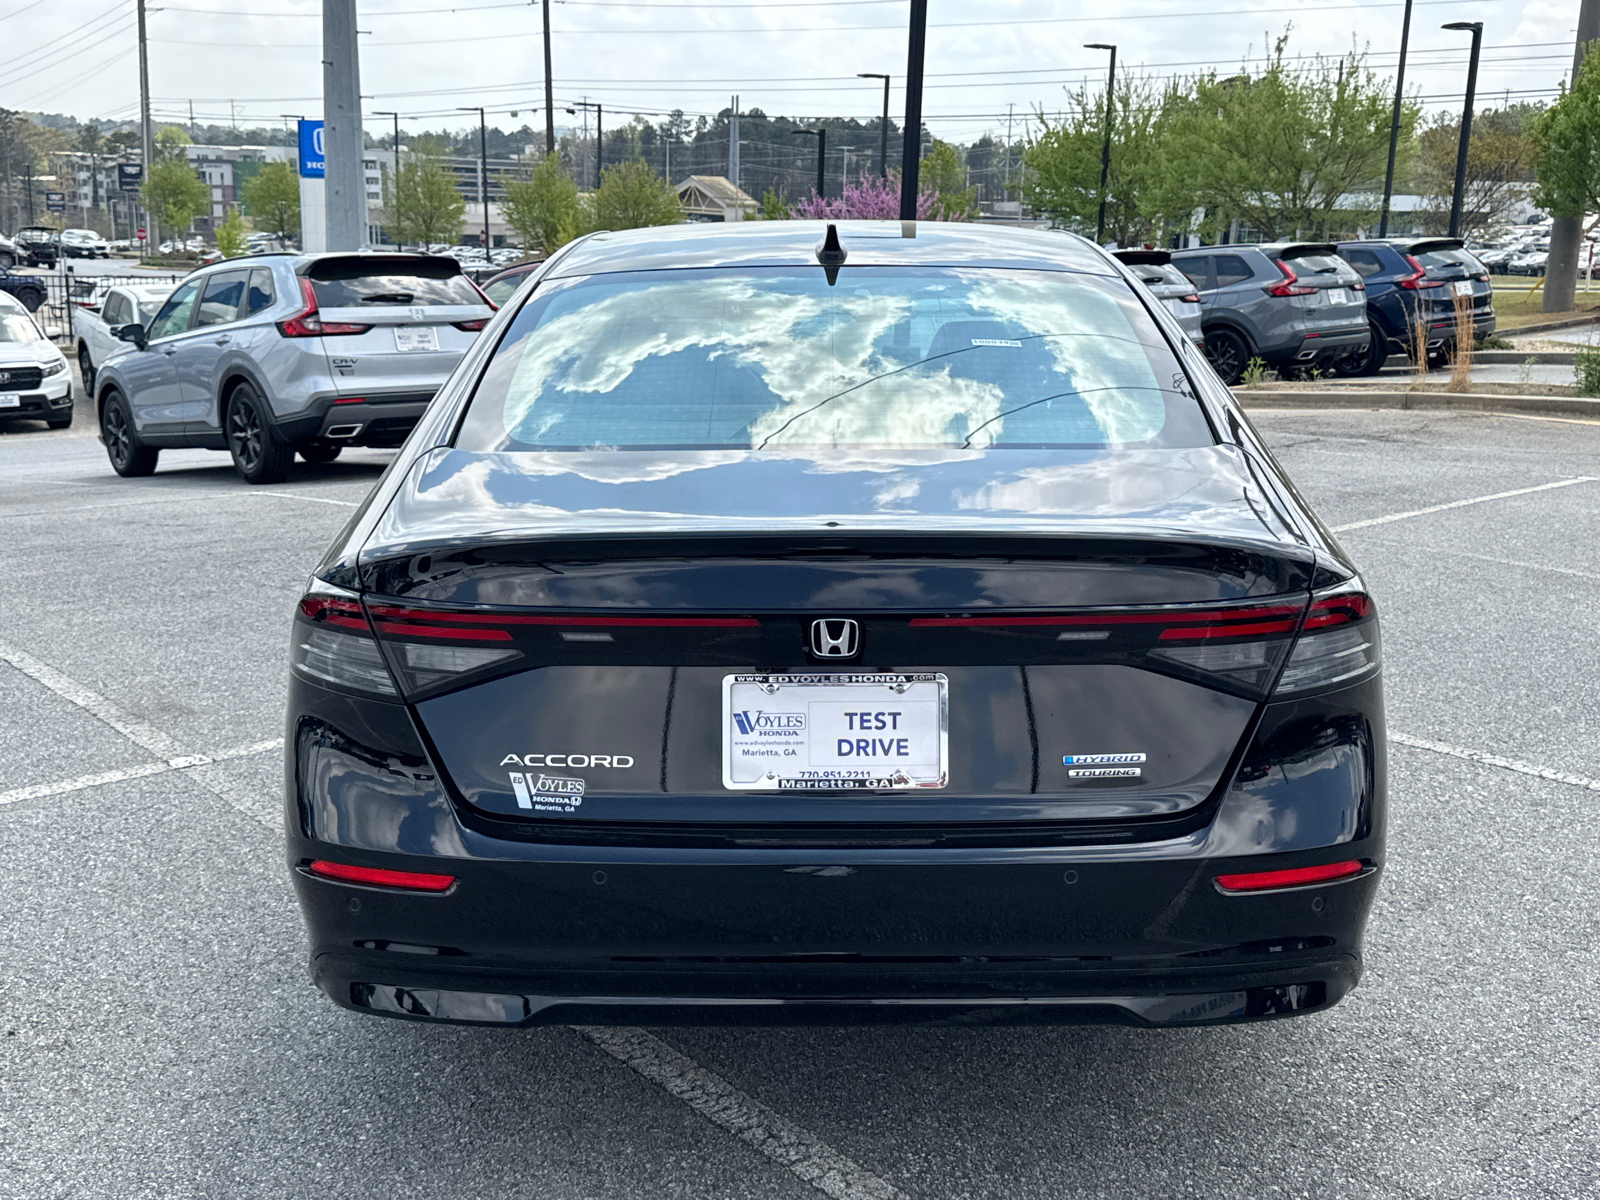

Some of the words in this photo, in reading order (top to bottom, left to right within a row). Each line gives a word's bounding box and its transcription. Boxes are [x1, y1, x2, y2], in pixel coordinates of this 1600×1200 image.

[742, 711, 804, 733] VOYLES
[844, 712, 902, 730] TEST
[742, 748, 781, 757] Marietta,
[783, 748, 797, 756] GA
[837, 739, 910, 757] DRIVE
[500, 753, 635, 768] ACCORD
[1075, 755, 1142, 764] HYBRID
[1073, 768, 1137, 777] TOURING
[512, 776, 524, 784] ED
[525, 772, 584, 796] VOYLES
[781, 779, 859, 788] Marietta,
[865, 779, 891, 788] GA
[532, 796, 571, 804] HONDA
[534, 804, 564, 812] Marietta,
[564, 805, 575, 813] GA
